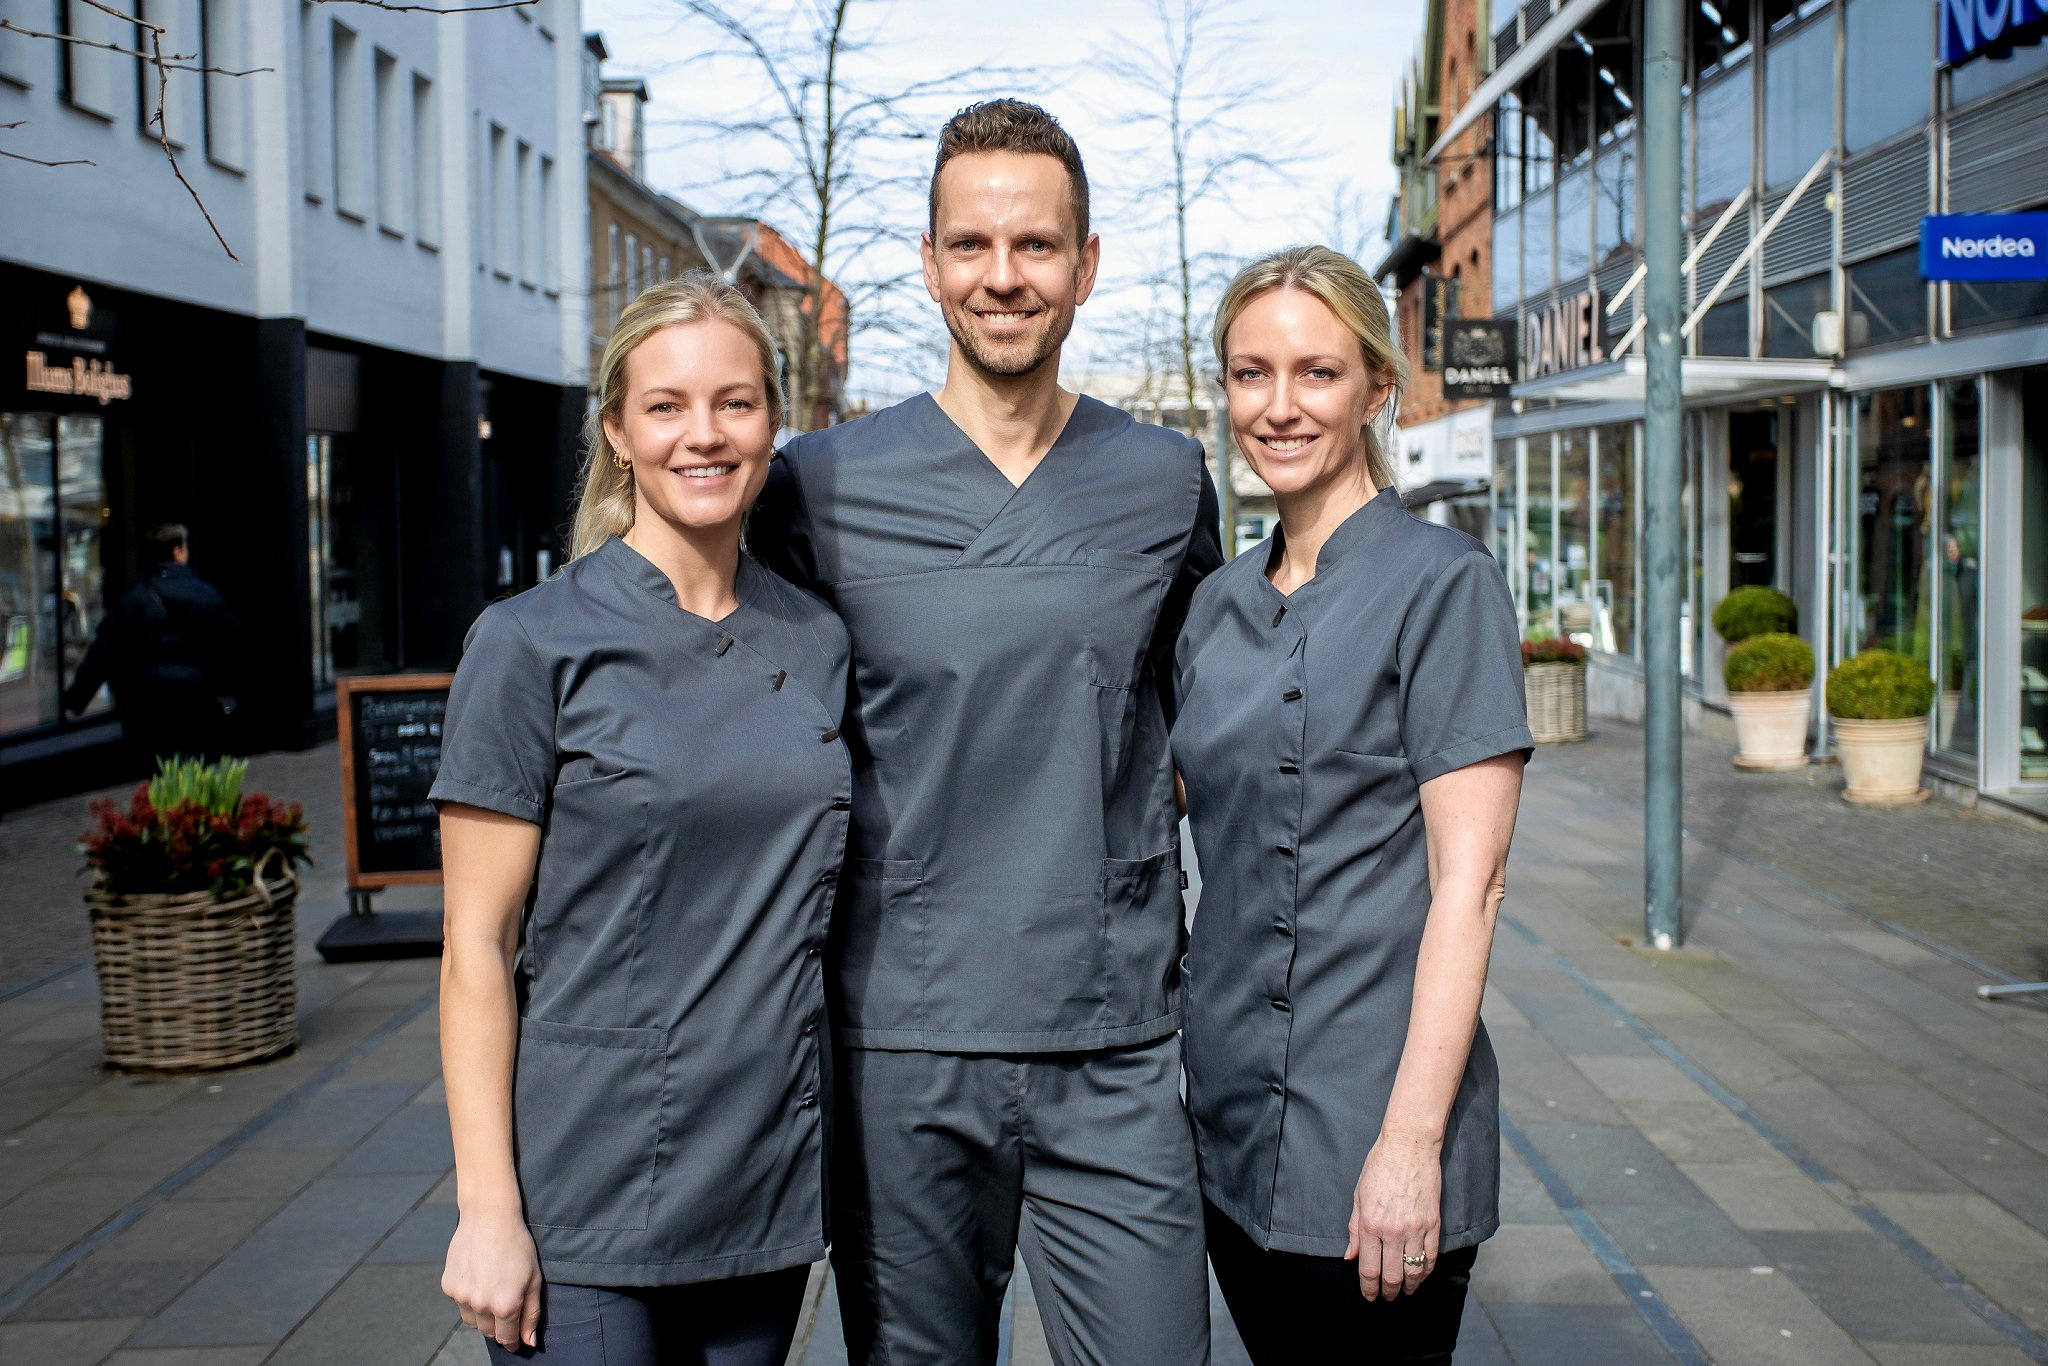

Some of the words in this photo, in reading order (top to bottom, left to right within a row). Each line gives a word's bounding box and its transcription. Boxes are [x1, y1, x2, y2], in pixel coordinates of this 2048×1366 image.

[1942, 234, 2035, 259] Nordea
[1526, 288, 1603, 379] DANIEL
[1445, 366, 1512, 385] DANIEL
